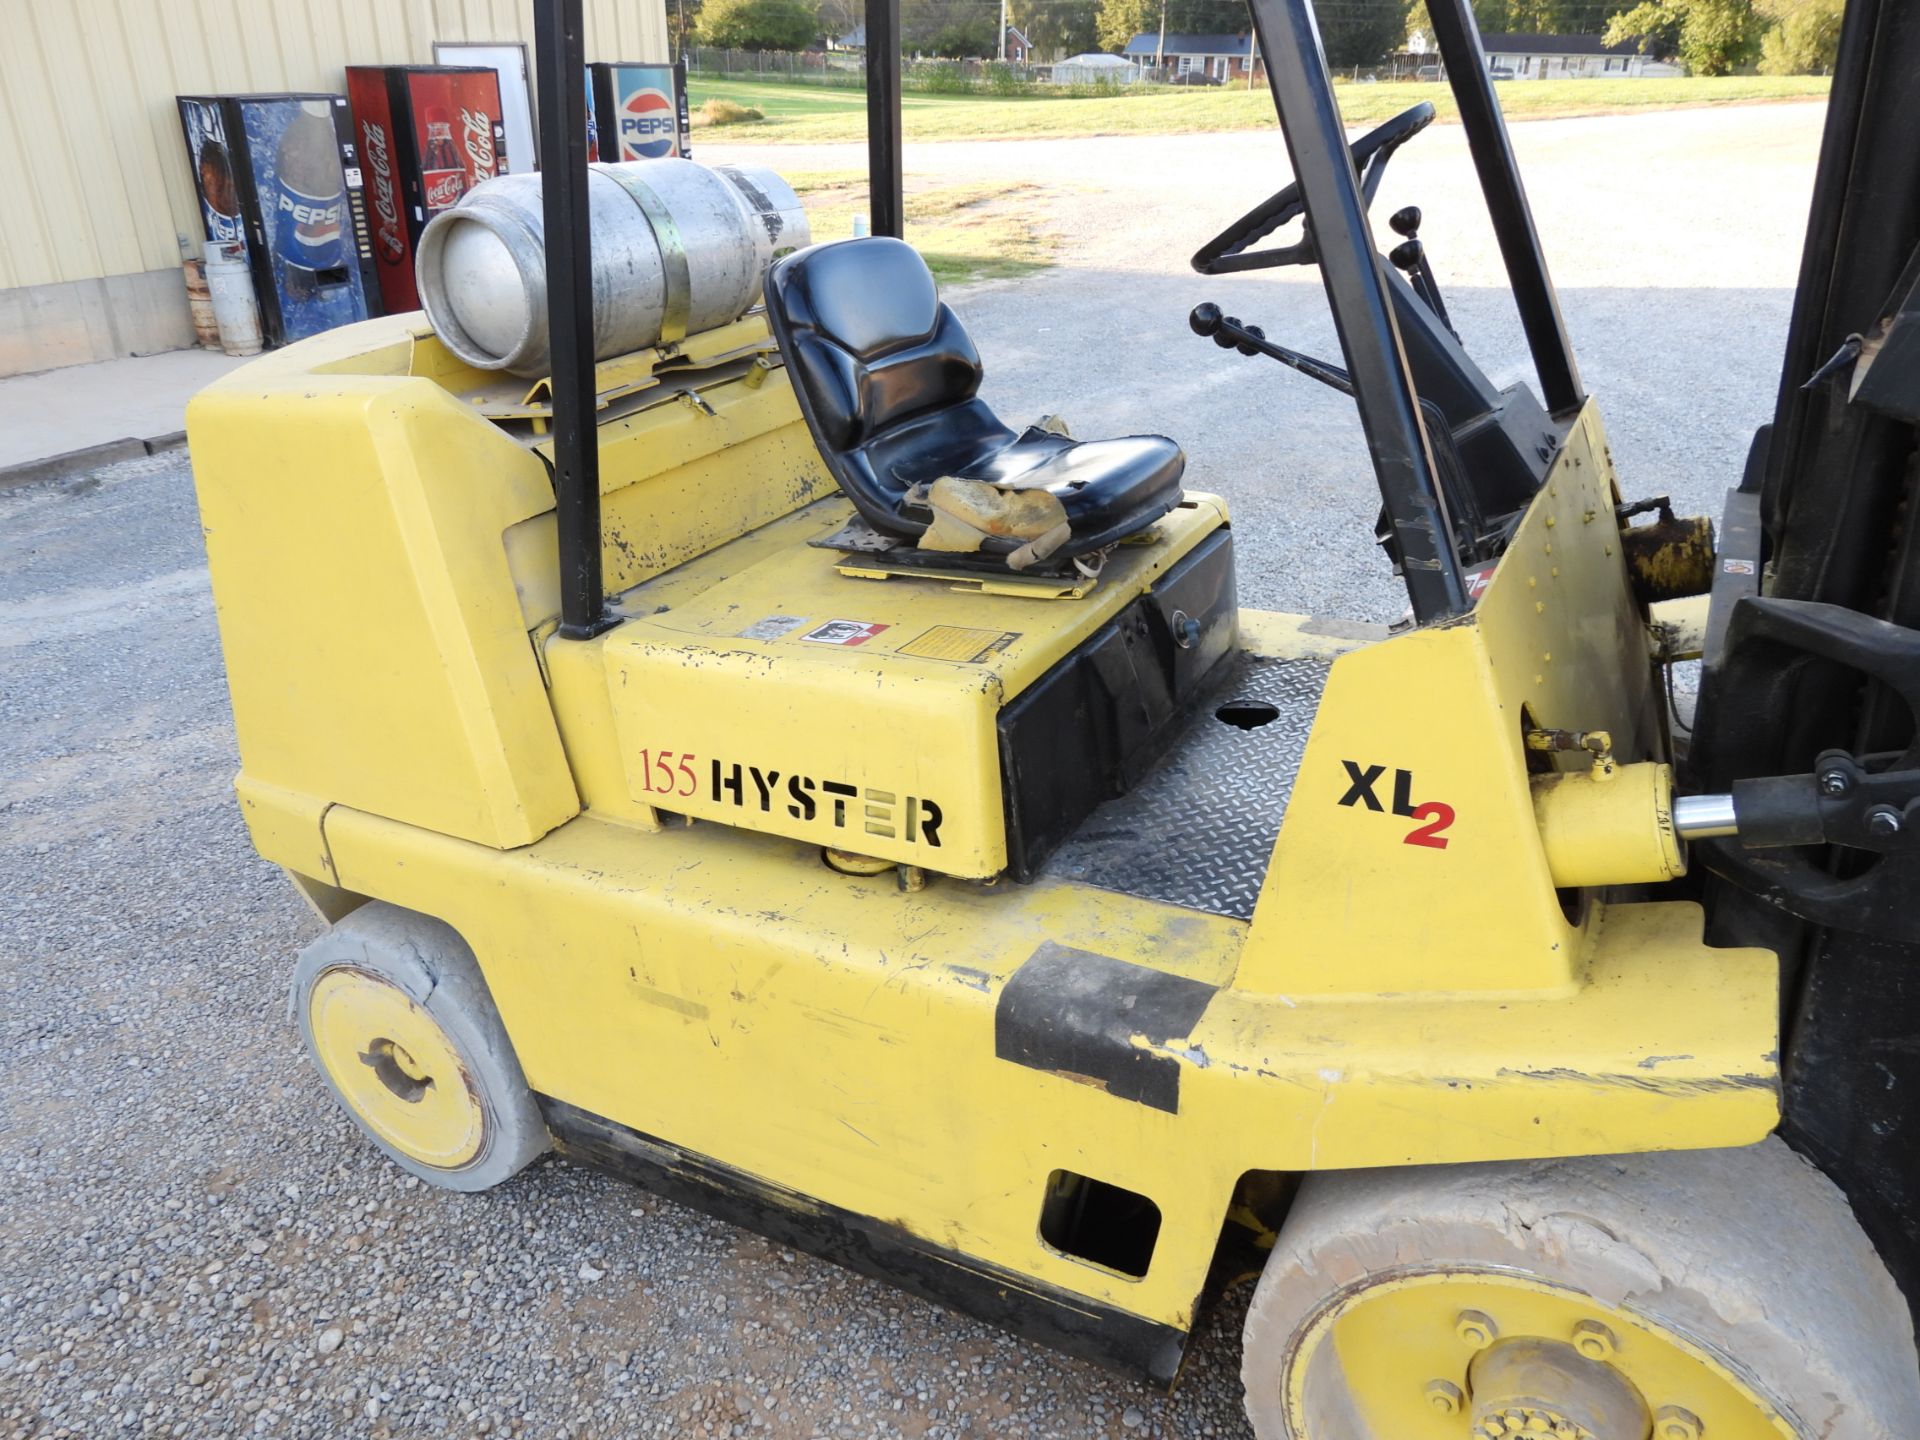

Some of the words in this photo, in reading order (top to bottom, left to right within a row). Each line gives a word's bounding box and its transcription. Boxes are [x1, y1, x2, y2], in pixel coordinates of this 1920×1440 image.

[621, 117, 675, 135] PEPSI
[639, 748, 697, 797] 155
[712, 759, 943, 848] HYSTER
